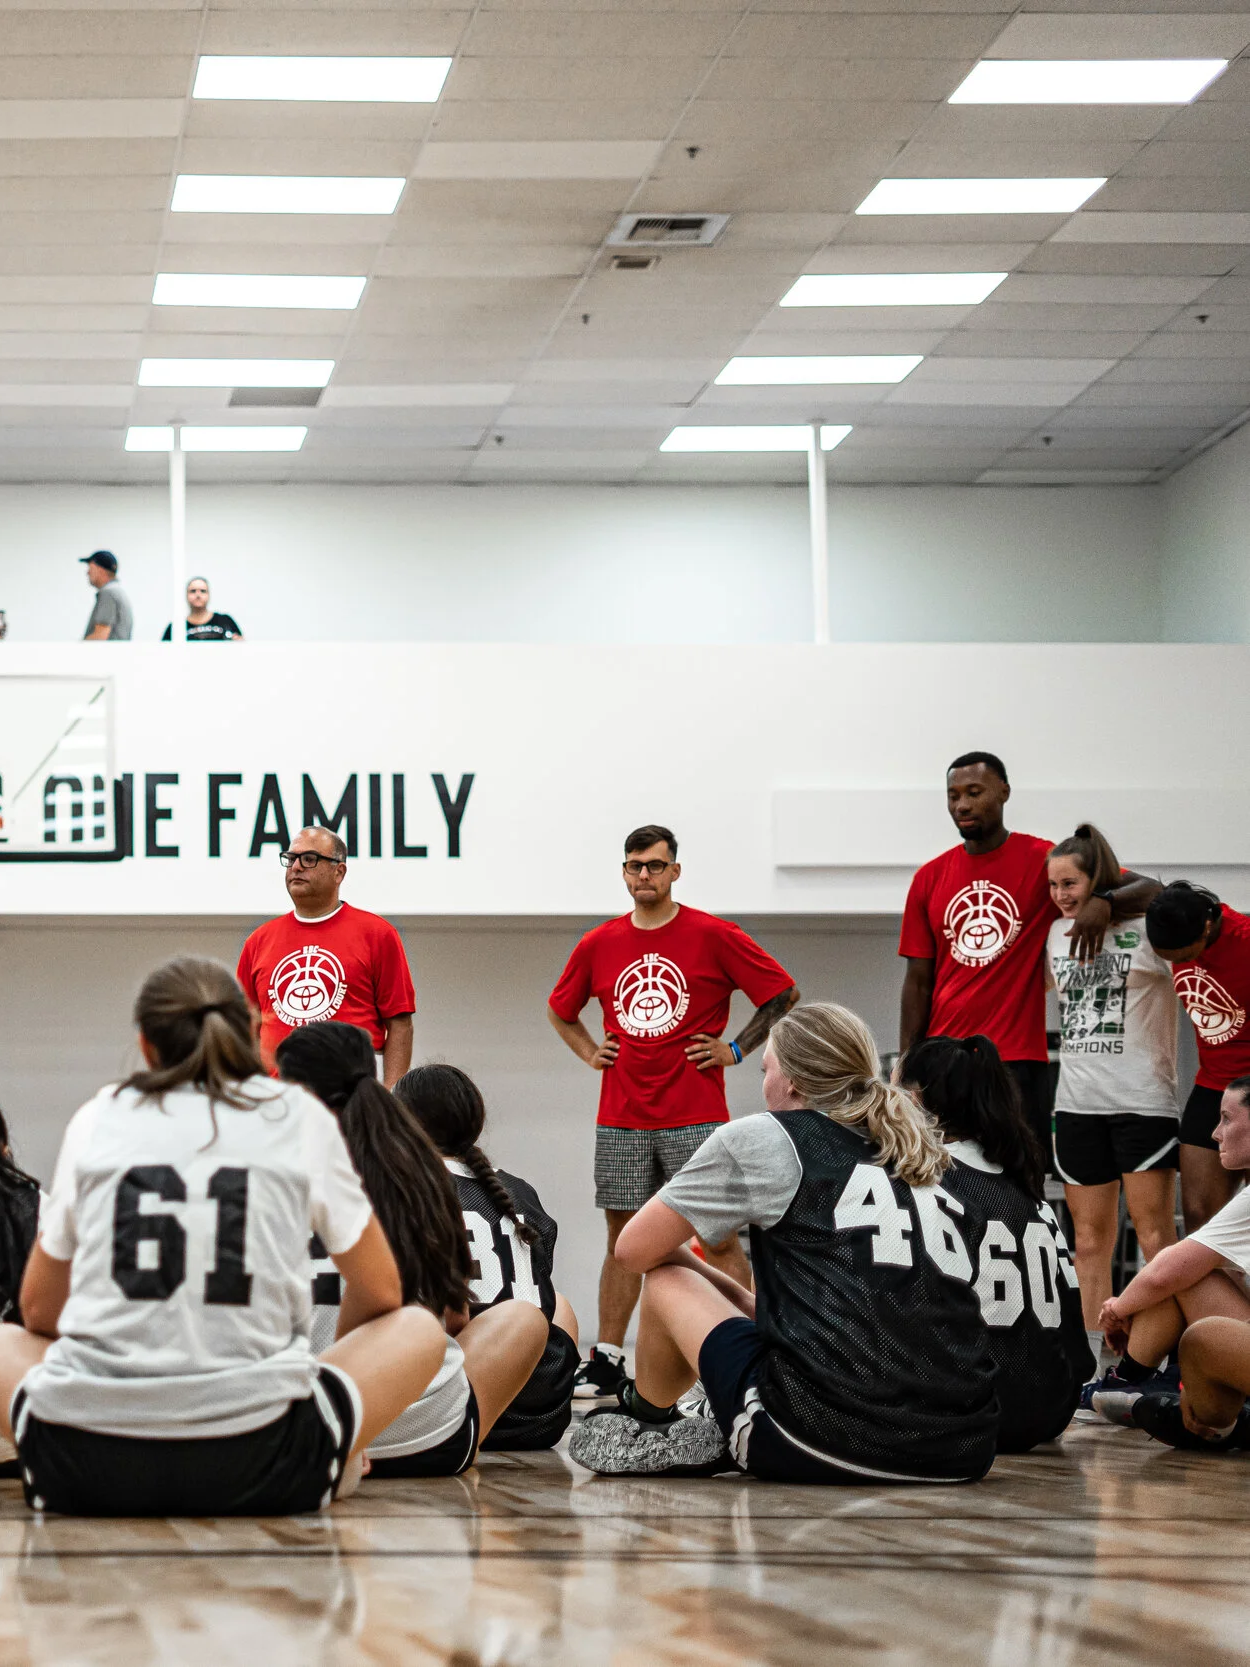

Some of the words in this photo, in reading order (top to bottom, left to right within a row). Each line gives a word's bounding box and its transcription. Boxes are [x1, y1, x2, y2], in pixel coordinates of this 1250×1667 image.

[208, 773, 476, 858] FAMILY
[647, 1018, 679, 1038] TOYOTA
[1062, 1040, 1124, 1054] MPIONS
[112, 1164, 253, 1306] 61
[833, 1163, 973, 1284] 46
[978, 1220, 1062, 1329] 60
